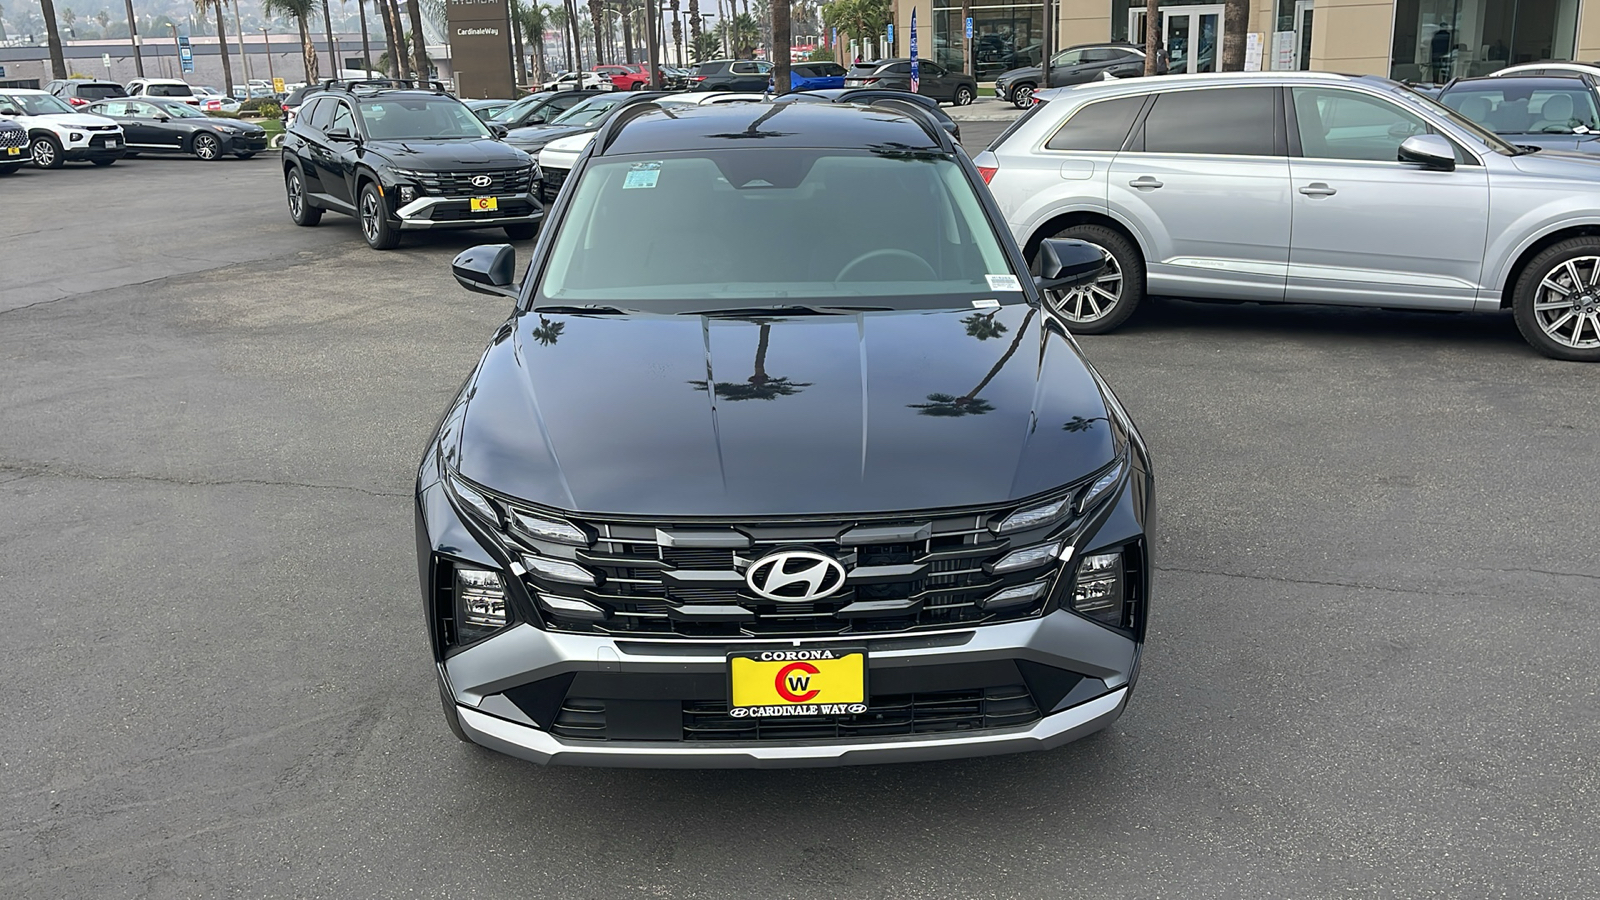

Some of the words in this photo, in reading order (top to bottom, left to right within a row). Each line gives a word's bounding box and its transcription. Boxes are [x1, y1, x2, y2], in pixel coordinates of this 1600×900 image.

[457, 27, 499, 36] CardinaleWay
[761, 650, 834, 661] CORONA
[749, 705, 818, 717] CARDINALE
[820, 704, 848, 714] WAY
